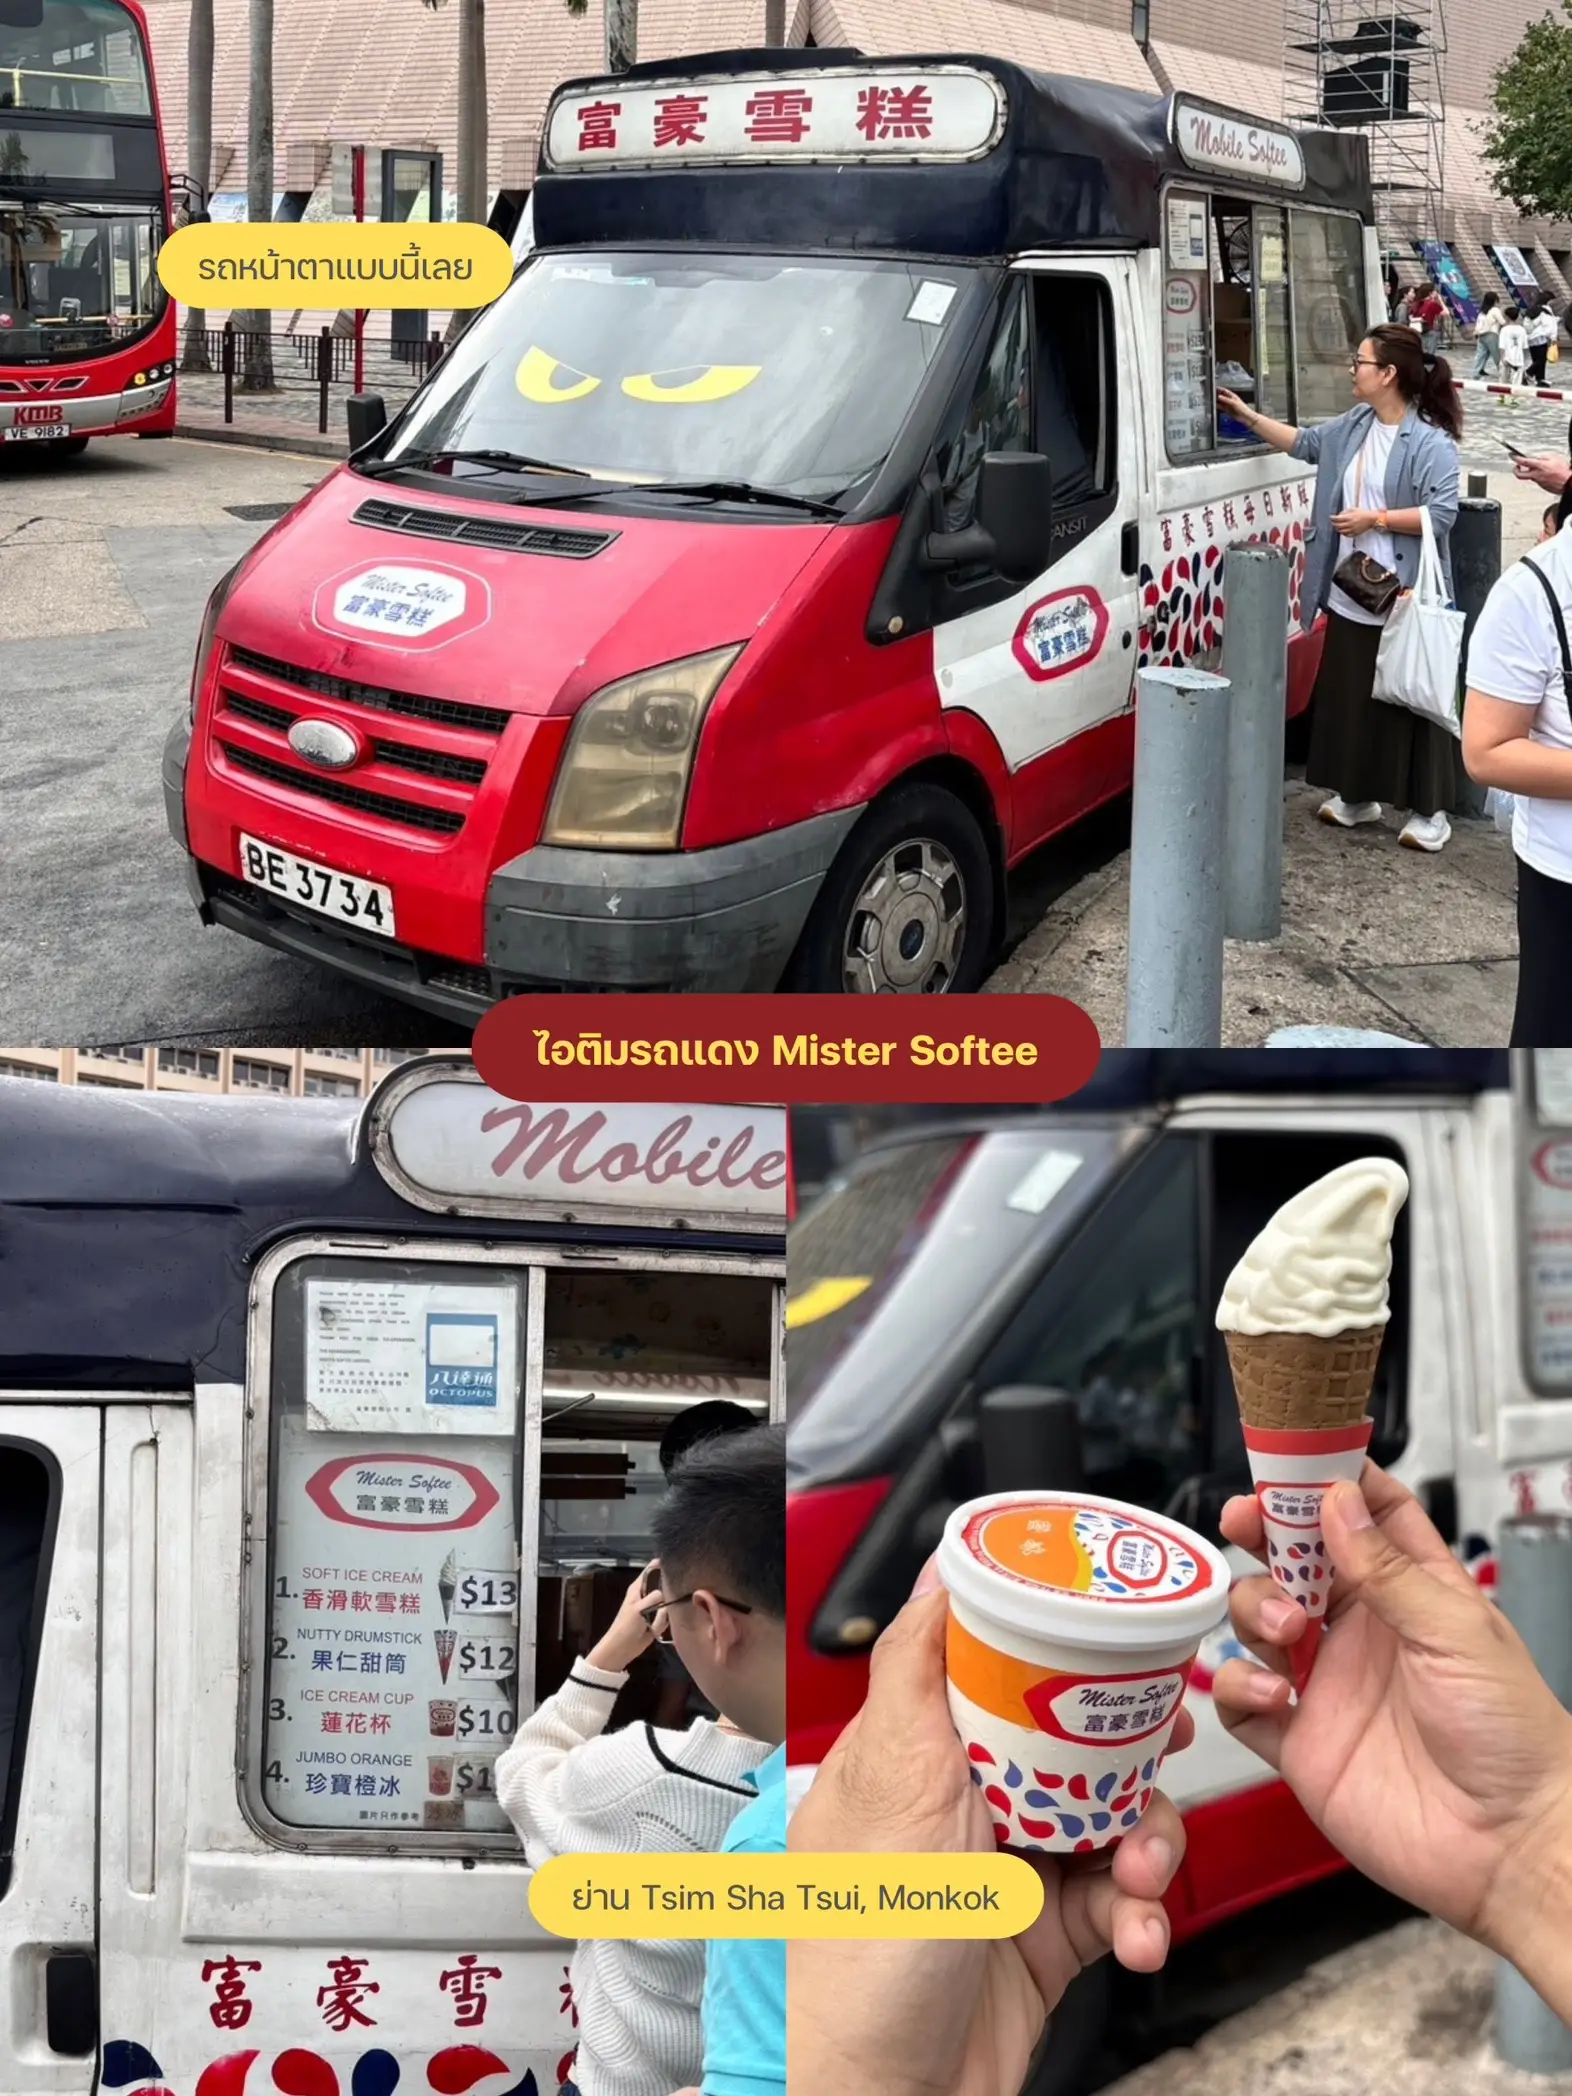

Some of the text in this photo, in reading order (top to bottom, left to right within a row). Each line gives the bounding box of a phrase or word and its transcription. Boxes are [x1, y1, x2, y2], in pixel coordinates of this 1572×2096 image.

[577, 85, 933, 151] 富豪雪糕
[1190, 116, 1287, 174] Mobile Softee
[14, 405, 63, 425] KMB
[11, 426, 64, 439] VE 9182
[1051, 515, 1087, 541] ANSIT
[343, 595, 434, 628] 富豪雪糕
[1038, 625, 1090, 663] 富豪雪糕
[247, 841, 383, 926] BE 3734
[481, 1104, 786, 1190] Mobile
[430, 1371, 493, 1386] 八達通
[429, 1388, 493, 1398] OCTOPUS
[356, 1470, 452, 1493] Mister Softee
[356, 1494, 449, 1515] 富豪雪糕
[275, 1576, 298, 1598] 1.
[302, 1568, 423, 1584] SOFT ICE CREAM
[302, 1588, 421, 1614] 香滑軟雪糕
[460, 1575, 517, 1609] $13
[297, 1628, 422, 1644] NUTTY DRUMSTICK
[271, 1637, 296, 1660] 2.
[459, 1642, 514, 1674] $12
[311, 1650, 407, 1674] 果仁甜筒
[300, 1690, 414, 1704] ICE CREAM CUP
[1079, 1681, 1179, 1707] Mister Softee
[269, 1698, 293, 1721] 3.
[458, 1705, 514, 1737] $10
[1084, 1703, 1165, 1733] 富豪雪糕
[320, 1711, 392, 1735] 蓮花杯
[295, 1751, 413, 1766] JUMBO ORANGE
[265, 1760, 290, 1783] 4.
[456, 1762, 493, 1794] $1
[305, 1773, 401, 1797] 珍寶橙冰
[201, 1955, 580, 2032] 富豪雪
